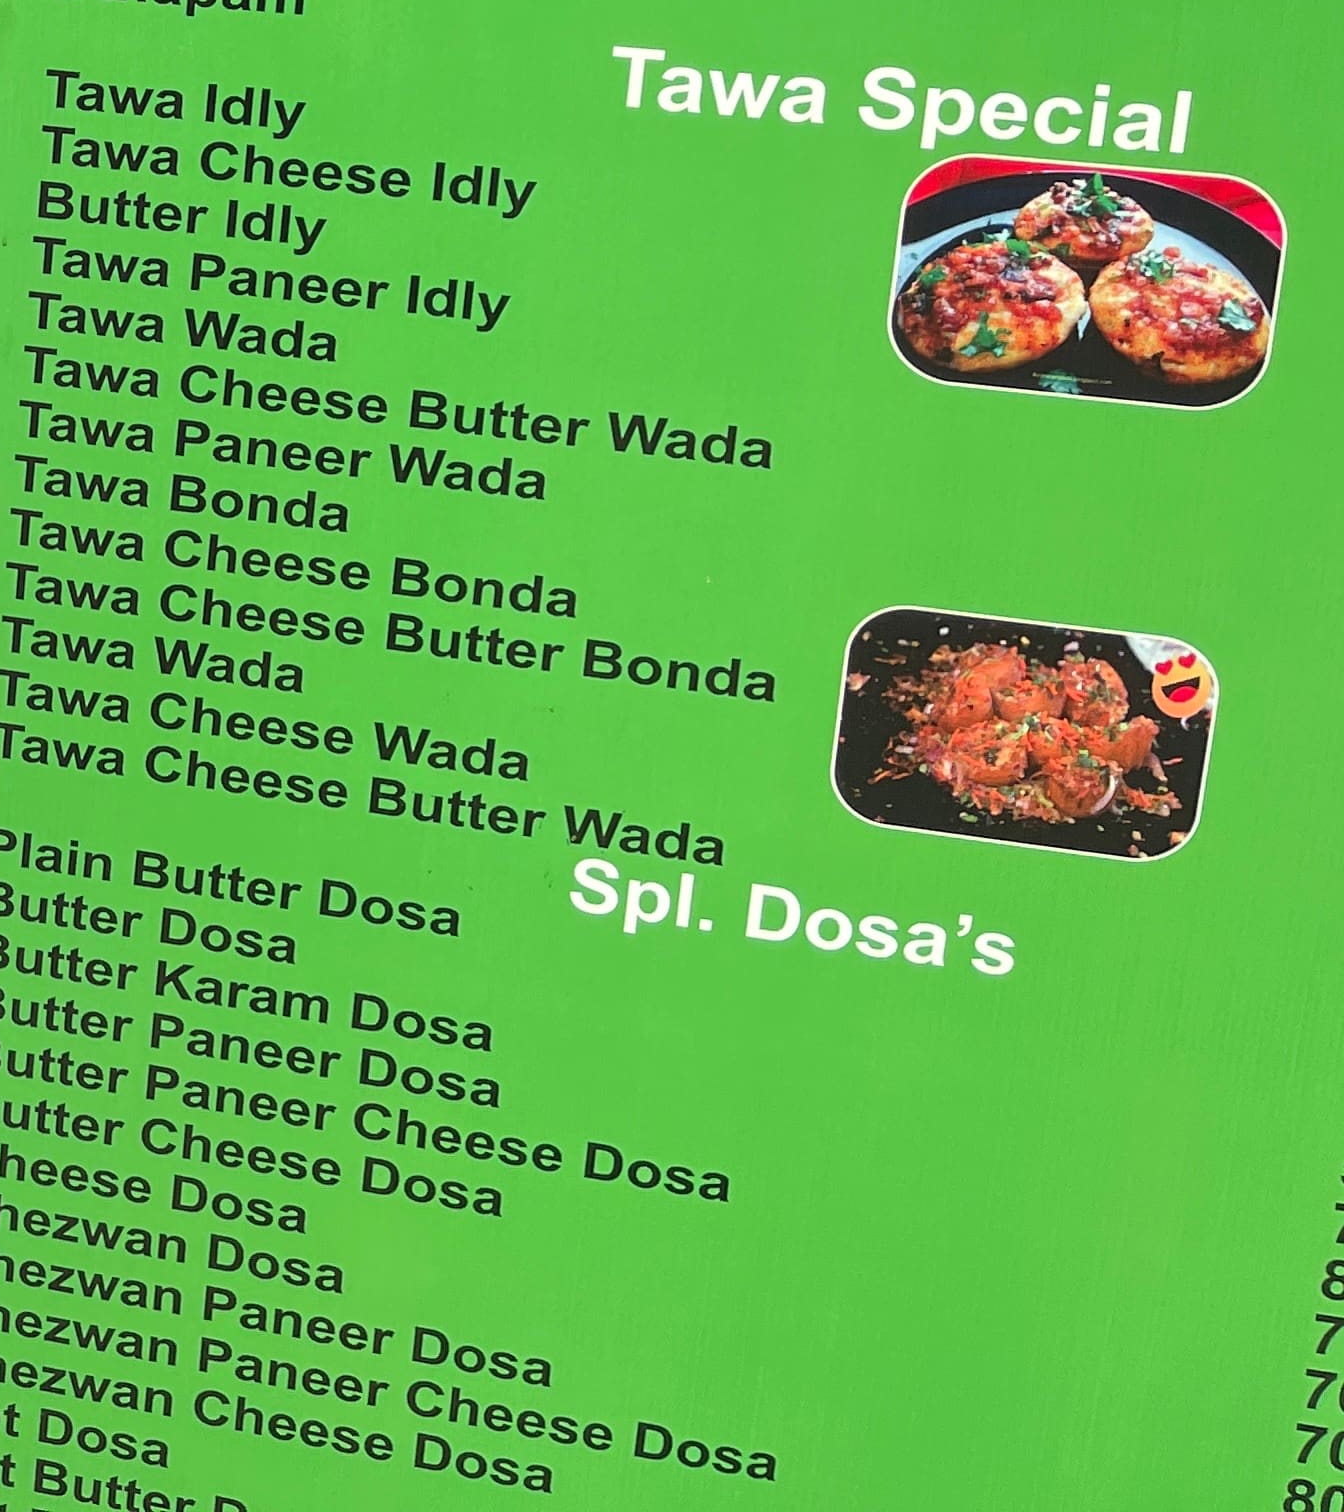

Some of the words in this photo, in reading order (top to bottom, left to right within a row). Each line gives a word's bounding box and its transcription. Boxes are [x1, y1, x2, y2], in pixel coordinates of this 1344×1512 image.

[47, 69, 182, 119] Tawa
[205, 84, 306, 139] Idly
[613, 46, 825, 123] Tawa
[859, 67, 1192, 152] Special
[38, 181, 208, 233] Butter
[227, 200, 326, 255] Idly
[42, 125, 178, 176] Tawa
[201, 142, 410, 197] Cheese
[433, 162, 537, 218] Idly
[29, 291, 163, 343] Tawa
[185, 309, 336, 361] Wada
[33, 236, 168, 287] Tawa
[191, 253, 389, 309] Paneer
[408, 275, 510, 332] Idly
[20, 400, 153, 452] Tawa
[176, 419, 372, 477] Paneer
[390, 444, 545, 500] Wada
[24, 346, 158, 397] Tawa
[181, 365, 387, 423] Cheese
[410, 390, 590, 446] Butter
[609, 412, 771, 469] Wada
[15, 454, 148, 507] Tawa
[170, 474, 347, 532] Bonda
[11, 508, 143, 561] Tawa
[165, 530, 370, 589] Cheese
[392, 557, 576, 618] Bonda
[2, 616, 133, 669] Tawa
[155, 637, 302, 693] Wada
[6, 562, 138, 615] Tawa
[161, 585, 364, 645] Cheese
[387, 613, 564, 671] Butter
[584, 639, 774, 702] Bonda
[151, 693, 353, 754] Cheese
[375, 722, 528, 781] Wada
[146, 746, 347, 808] Cheese
[369, 777, 546, 837] Butter
[565, 806, 723, 866] Wada
[134, 850, 302, 909] Butter
[320, 879, 459, 936] Dosa
[160, 908, 295, 964] Dosa
[570, 859, 712, 933] Spl.
[746, 884, 1014, 974] Dosa's
[156, 960, 328, 1023] Karam
[352, 993, 491, 1051] Dosa
[151, 1013, 341, 1077] Paneer
[360, 1048, 499, 1107] Dosa
[142, 1119, 340, 1185] Cheese
[362, 1157, 501, 1217] Dosa
[146, 1065, 336, 1130] Paneer
[354, 1103, 562, 1171] Cheese
[584, 1142, 729, 1202] Dosa
[172, 1175, 305, 1234] Dosa
[208, 1234, 342, 1293] Dosa
[204, 1286, 394, 1354] Paneer
[412, 1327, 550, 1387] Dosa
[199, 1337, 389, 1406] Paneer
[407, 1381, 612, 1450] Cheese
[635, 1422, 775, 1481] Dosa
[1306, 1369, 1344, 1411] 7
[38, 1408, 168, 1468] Dosa
[195, 1391, 393, 1460] Cheese
[415, 1433, 552, 1493] Dosa
[34, 1459, 195, 1512] Butter
